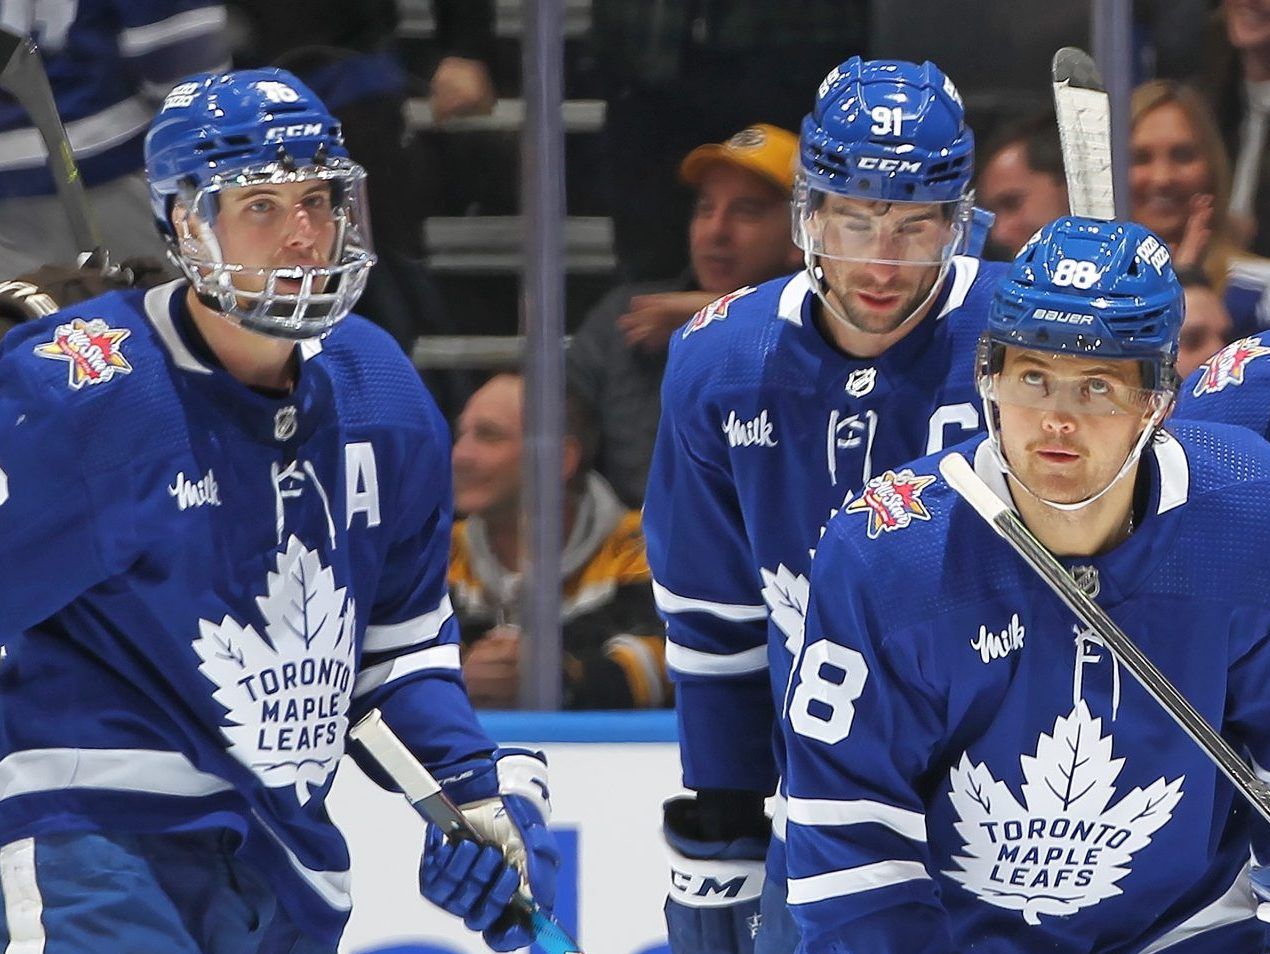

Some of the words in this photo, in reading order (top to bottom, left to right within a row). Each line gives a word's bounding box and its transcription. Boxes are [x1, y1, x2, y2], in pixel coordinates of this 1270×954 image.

[264, 122, 323, 142] CCM
[870, 106, 903, 137] 91
[857, 157, 922, 173] CCM
[1052, 257, 1102, 290] 88
[1032, 308, 1095, 325] BAUER
[721, 409, 779, 448] Milk
[926, 402, 980, 456] C
[168, 468, 222, 502] Milk
[345, 441, 382, 531] A
[970, 612, 1025, 664] Milk
[237, 657, 351, 702] TORONTO
[261, 692, 340, 723] MAPLE
[257, 721, 338, 751] LEAFS
[979, 817, 1132, 850] TORONTO
[997, 843, 1103, 866] MAPLE
[989, 864, 1094, 888] LEAFS
